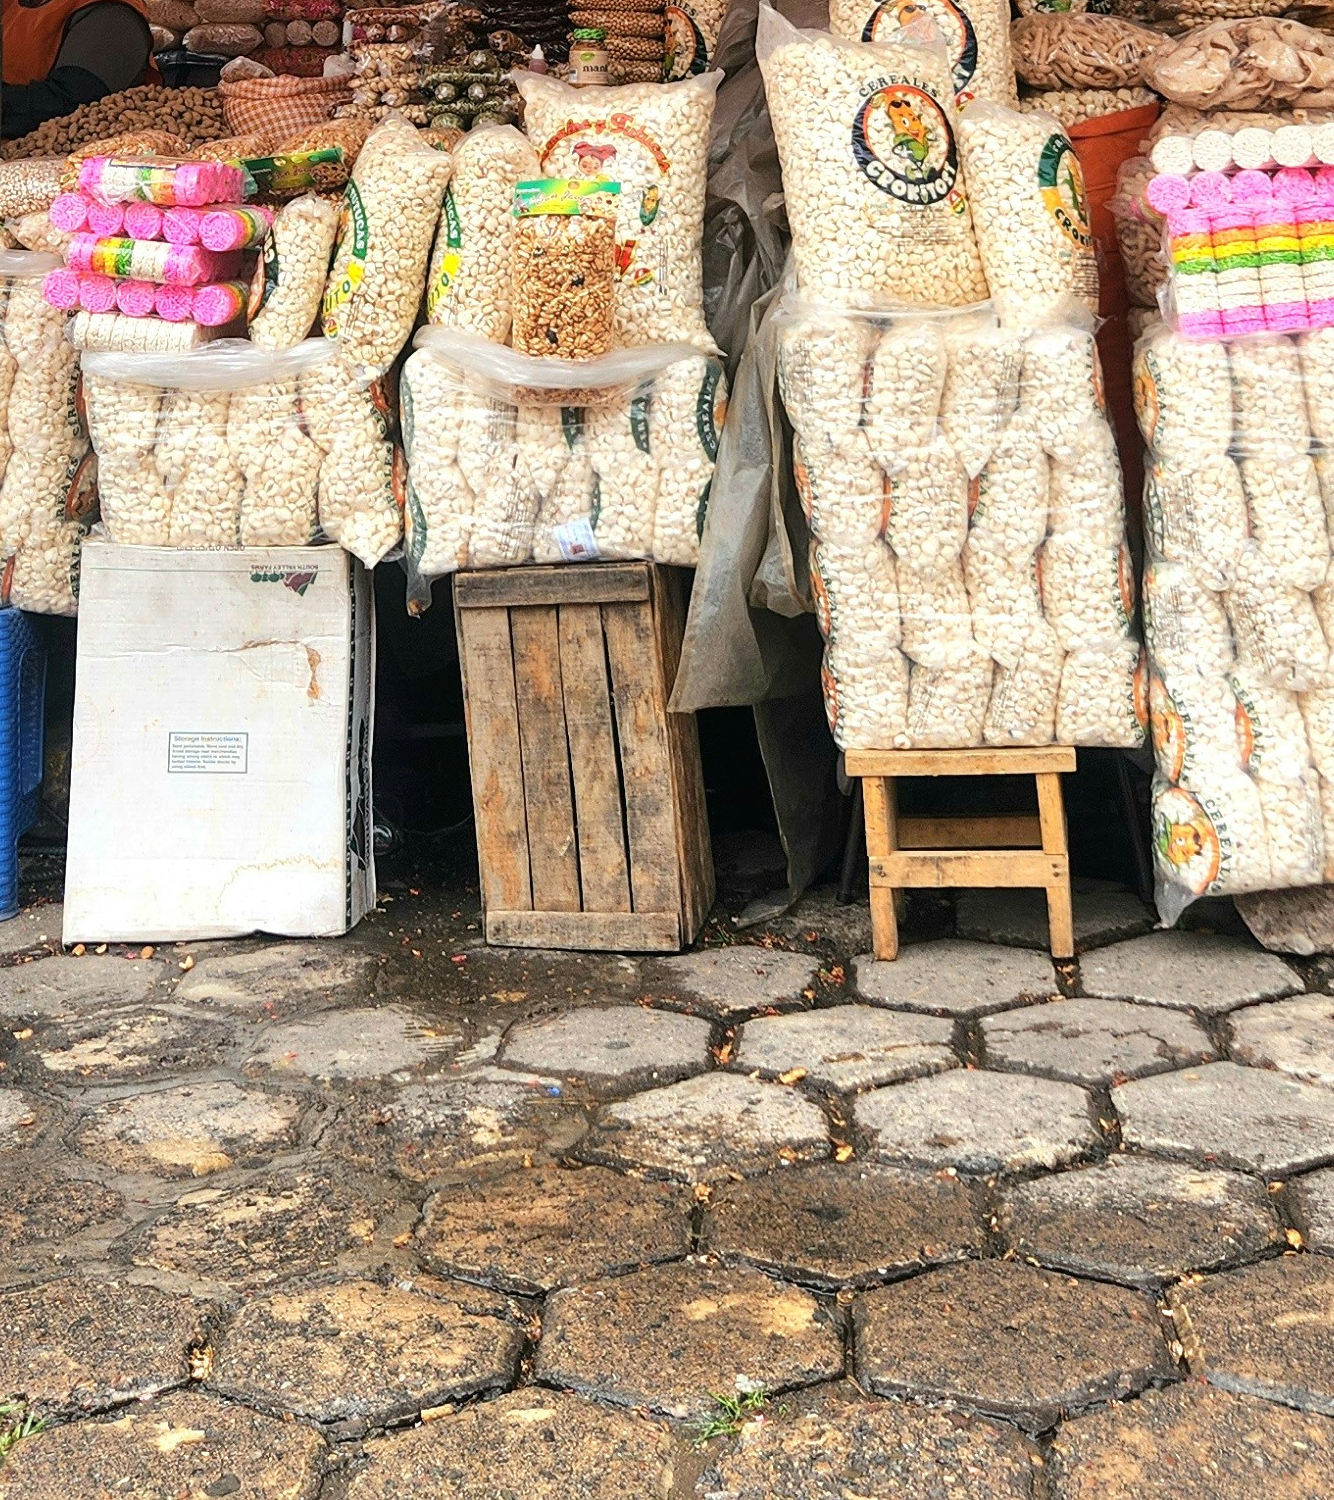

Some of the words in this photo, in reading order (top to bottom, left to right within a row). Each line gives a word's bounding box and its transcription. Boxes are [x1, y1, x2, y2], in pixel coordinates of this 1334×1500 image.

[858, 73, 939, 100] CEREALES
[56, 457, 79, 521] REALES
[1125, 653, 1144, 741] EREALES
[1205, 798, 1232, 894] CEREALS
